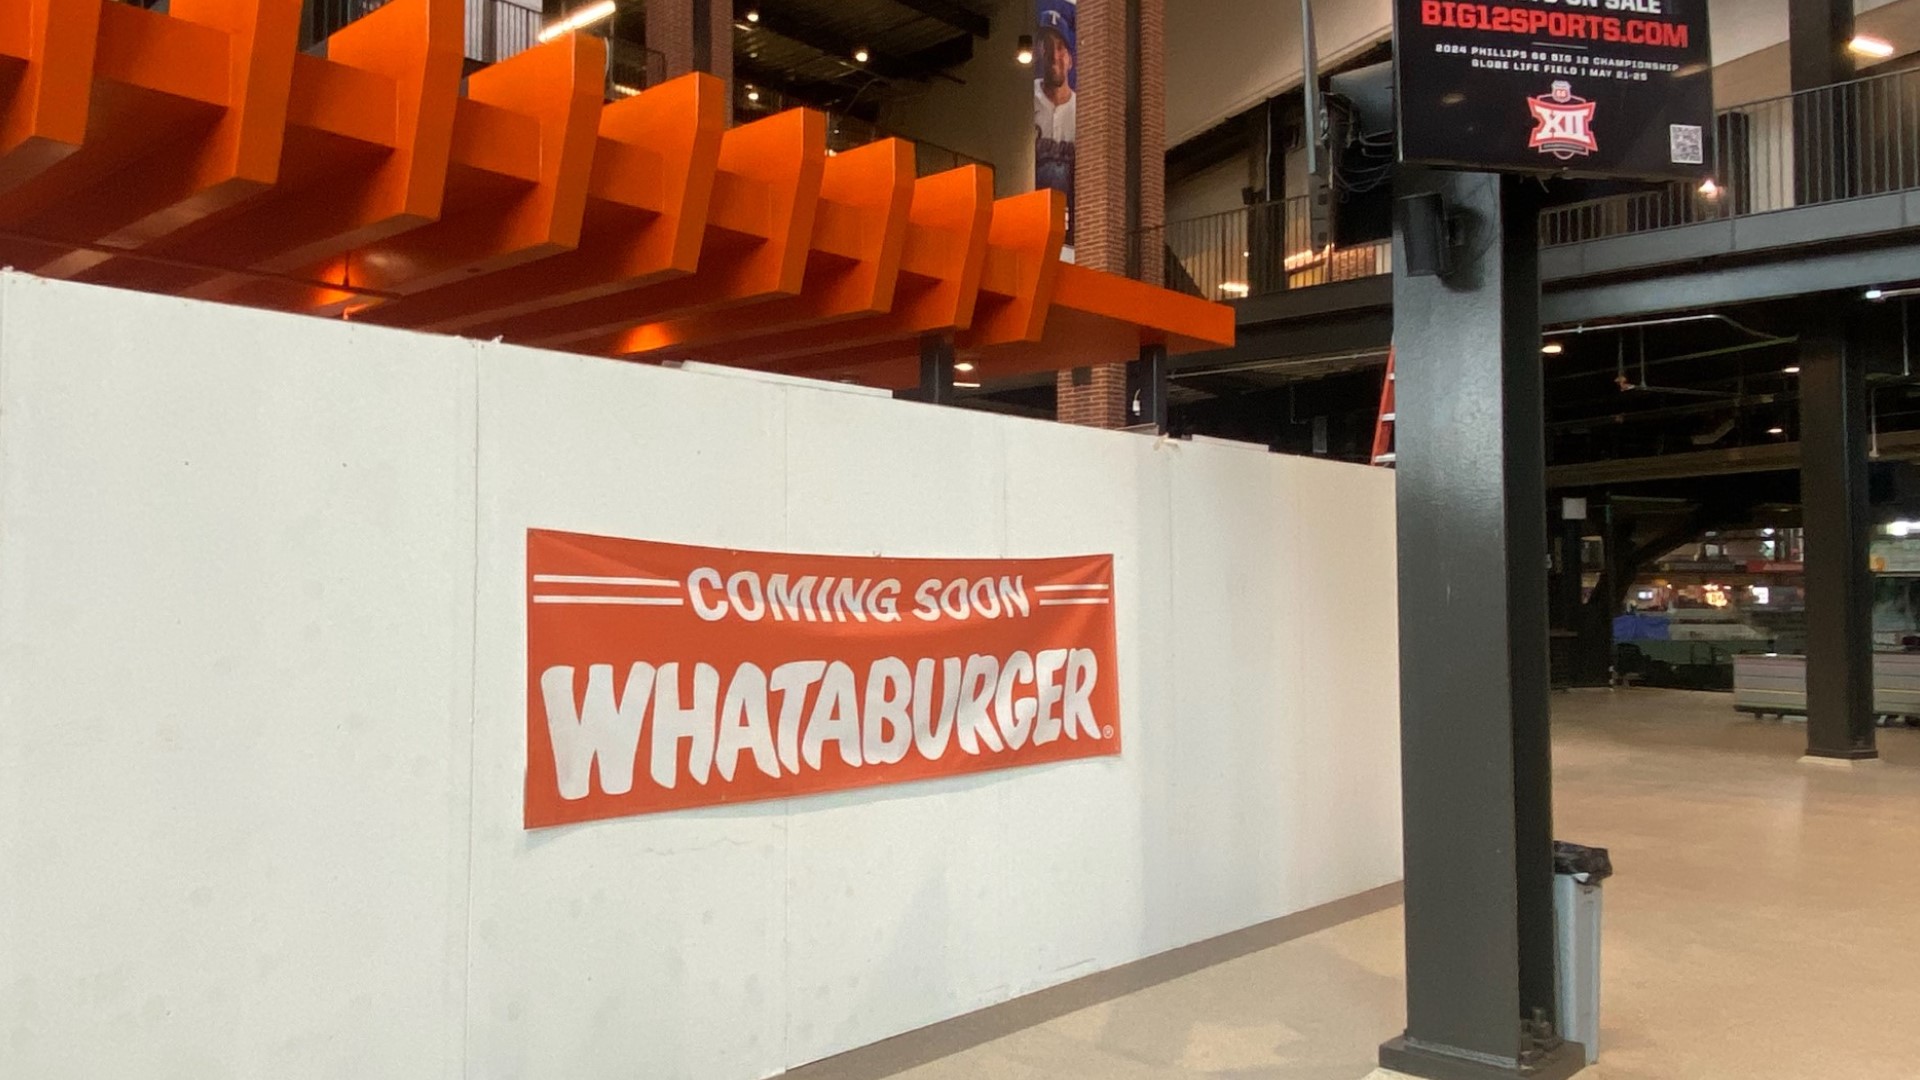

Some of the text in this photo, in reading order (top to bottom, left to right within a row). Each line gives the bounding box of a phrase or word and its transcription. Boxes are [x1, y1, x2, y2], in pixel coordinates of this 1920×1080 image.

[1421, 0, 1689, 48] BIG12SPORTS.COM
[1604, 0, 1662, 14] SALE
[1435, 43, 1680, 72] 2024 PHILLIPS 66 BIG 12 CHAMPIONSHIP
[1471, 59, 1510, 70] GLOBE
[1513, 62, 1540, 72] LIFE
[1543, 64, 1578, 76] FIELD
[1589, 68, 1613, 78] MAY
[1616, 70, 1648, 81] 21-25
[1534, 105, 1592, 144] XII
[687, 567, 1030, 622] COMING SOON
[541, 648, 1102, 800] WHATABURGER
